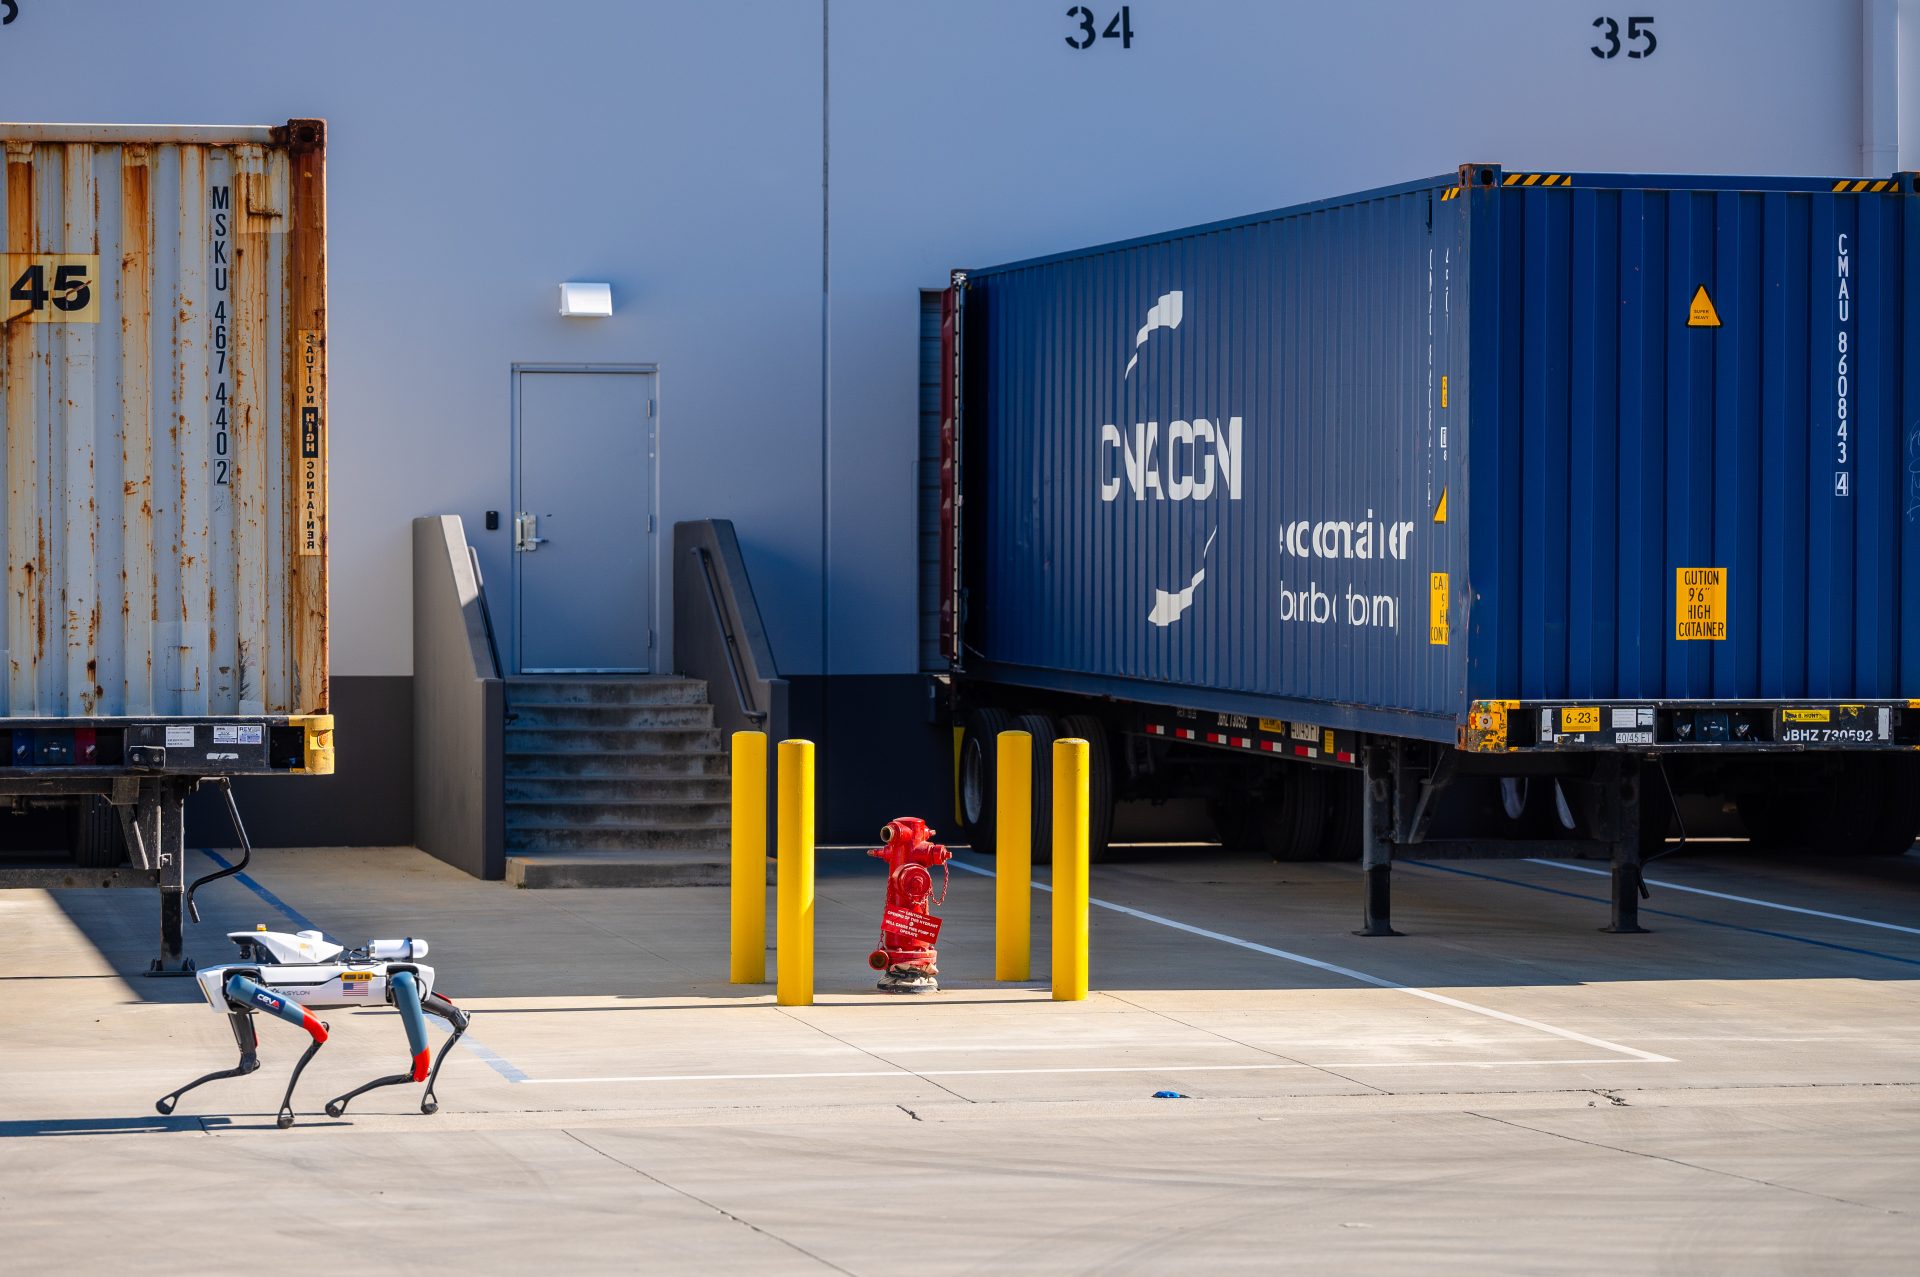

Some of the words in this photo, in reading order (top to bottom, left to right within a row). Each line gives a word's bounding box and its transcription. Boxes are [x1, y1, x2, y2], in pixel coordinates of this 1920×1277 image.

[1065, 6, 1134, 49] 34
[1590, 16, 1657, 59] 35
[212, 186, 230, 291] MSKU
[10, 264, 91, 312] 45
[1837, 233, 1850, 322] CMAU
[1836, 331, 1848, 464] 860843
[215, 460, 228, 485] 2
[1837, 473, 1848, 496] 4
[1688, 604, 1711, 619] HIGH
[1783, 729, 1819, 742] JBHZ
[1822, 729, 1874, 742] 730592
